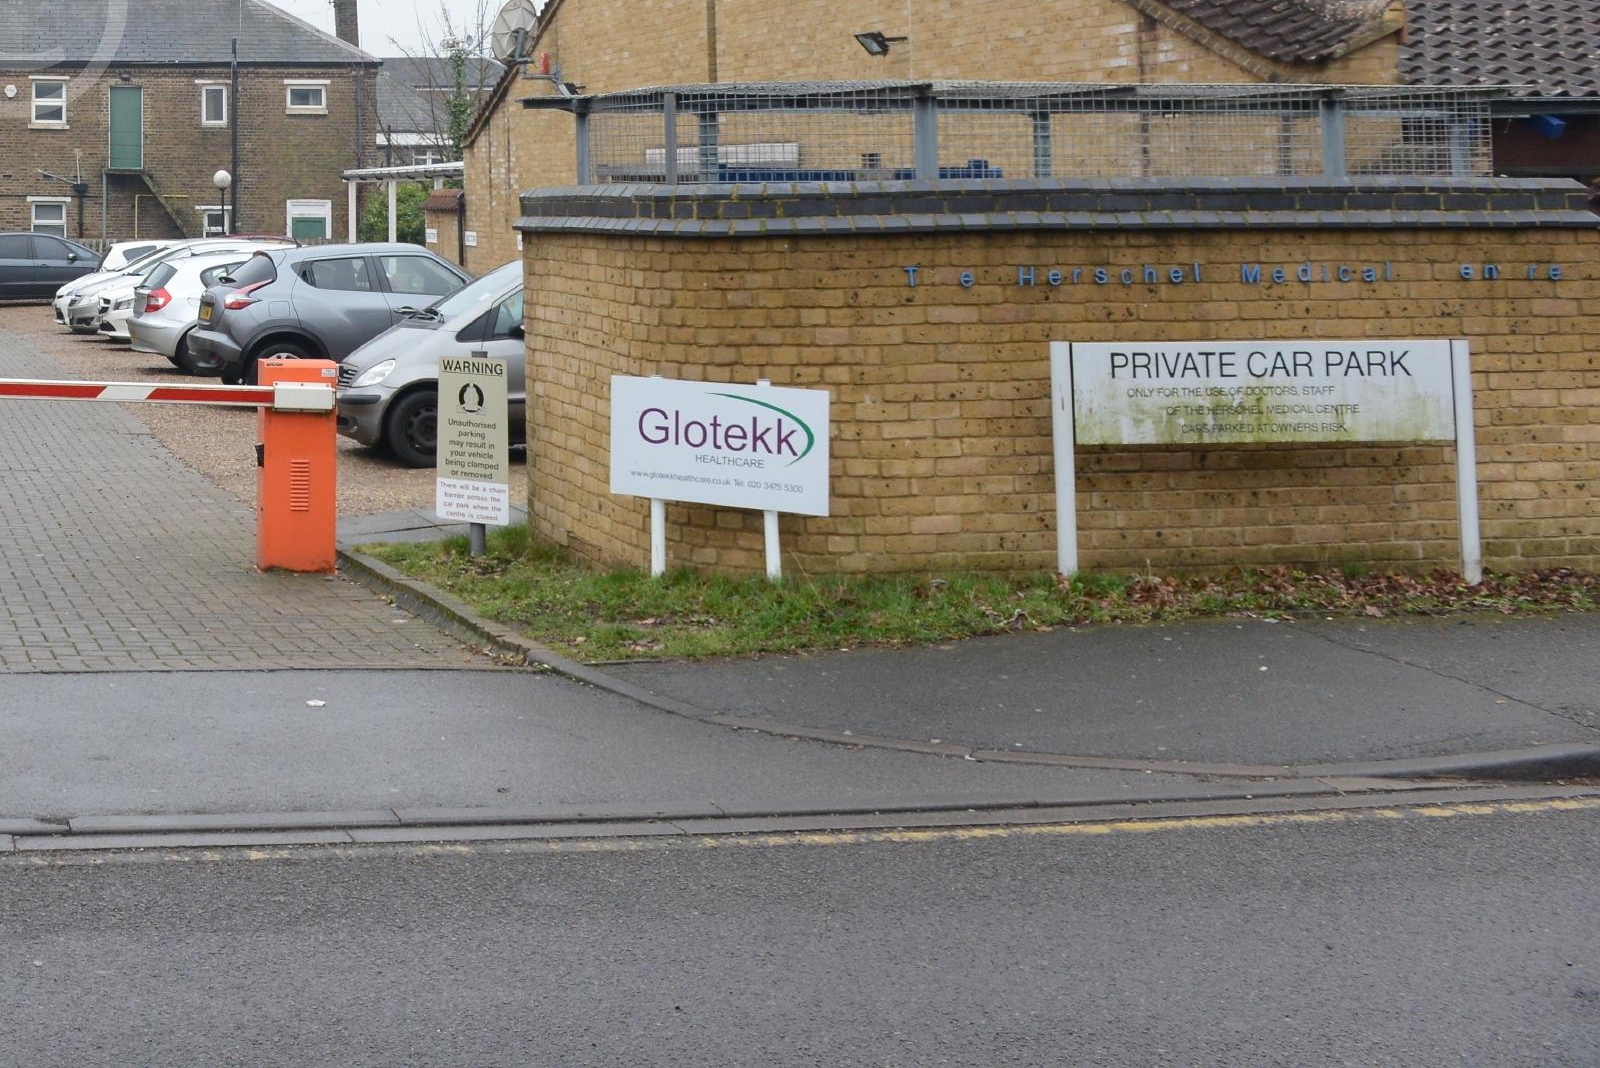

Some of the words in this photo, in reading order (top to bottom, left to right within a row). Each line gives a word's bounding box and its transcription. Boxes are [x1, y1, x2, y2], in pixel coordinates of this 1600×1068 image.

[903, 266, 976, 288] Te
[1017, 261, 1202, 286] Herschel
[1240, 260, 1392, 283] Medical
[442, 359, 503, 375] WARNING
[1110, 351, 1238, 379] PRIVATE
[1247, 350, 1313, 378] CAR
[1325, 349, 1413, 377] PARK
[1127, 387, 1155, 398] ONLY
[1157, 387, 1179, 397] FOR
[1182, 387, 1203, 397] THE
[1205, 386, 1226, 397] USE
[1228, 386, 1244, 396] OF
[1302, 385, 1335, 396] STAFF
[1166, 405, 1181, 416] OF
[1183, 405, 1204, 415] THE
[1207, 404, 1264, 415] HERSCHEL
[1266, 403, 1314, 414] MEDICAL
[1315, 403, 1361, 414] CENTRE
[447, 417, 497, 430] Unauthorised
[1181, 423, 1209, 434] CARS
[1212, 423, 1254, 433] PARKED
[1270, 422, 1319, 433] OWNERS
[1321, 422, 1348, 433] RISK
[458, 430, 485, 441] parking
[638, 407, 799, 457] Glotekk
[448, 440, 464, 448] may
[465, 440, 487, 449] result
[488, 442, 495, 450] in
[468, 451, 494, 460] vehicle
[695, 454, 765, 469] HEALTHCARE
[445, 458, 466, 469] being
[466, 460, 500, 471] clamped
[460, 470, 493, 480] removed
[440, 481, 457, 489] There
[471, 484, 480, 492] be
[746, 480, 762, 489] 020
[783, 484, 804, 493] 5300
[466, 494, 488, 502] across
[490, 495, 500, 503] the
[456, 502, 469, 510] park
[476, 513, 498, 521] closed
